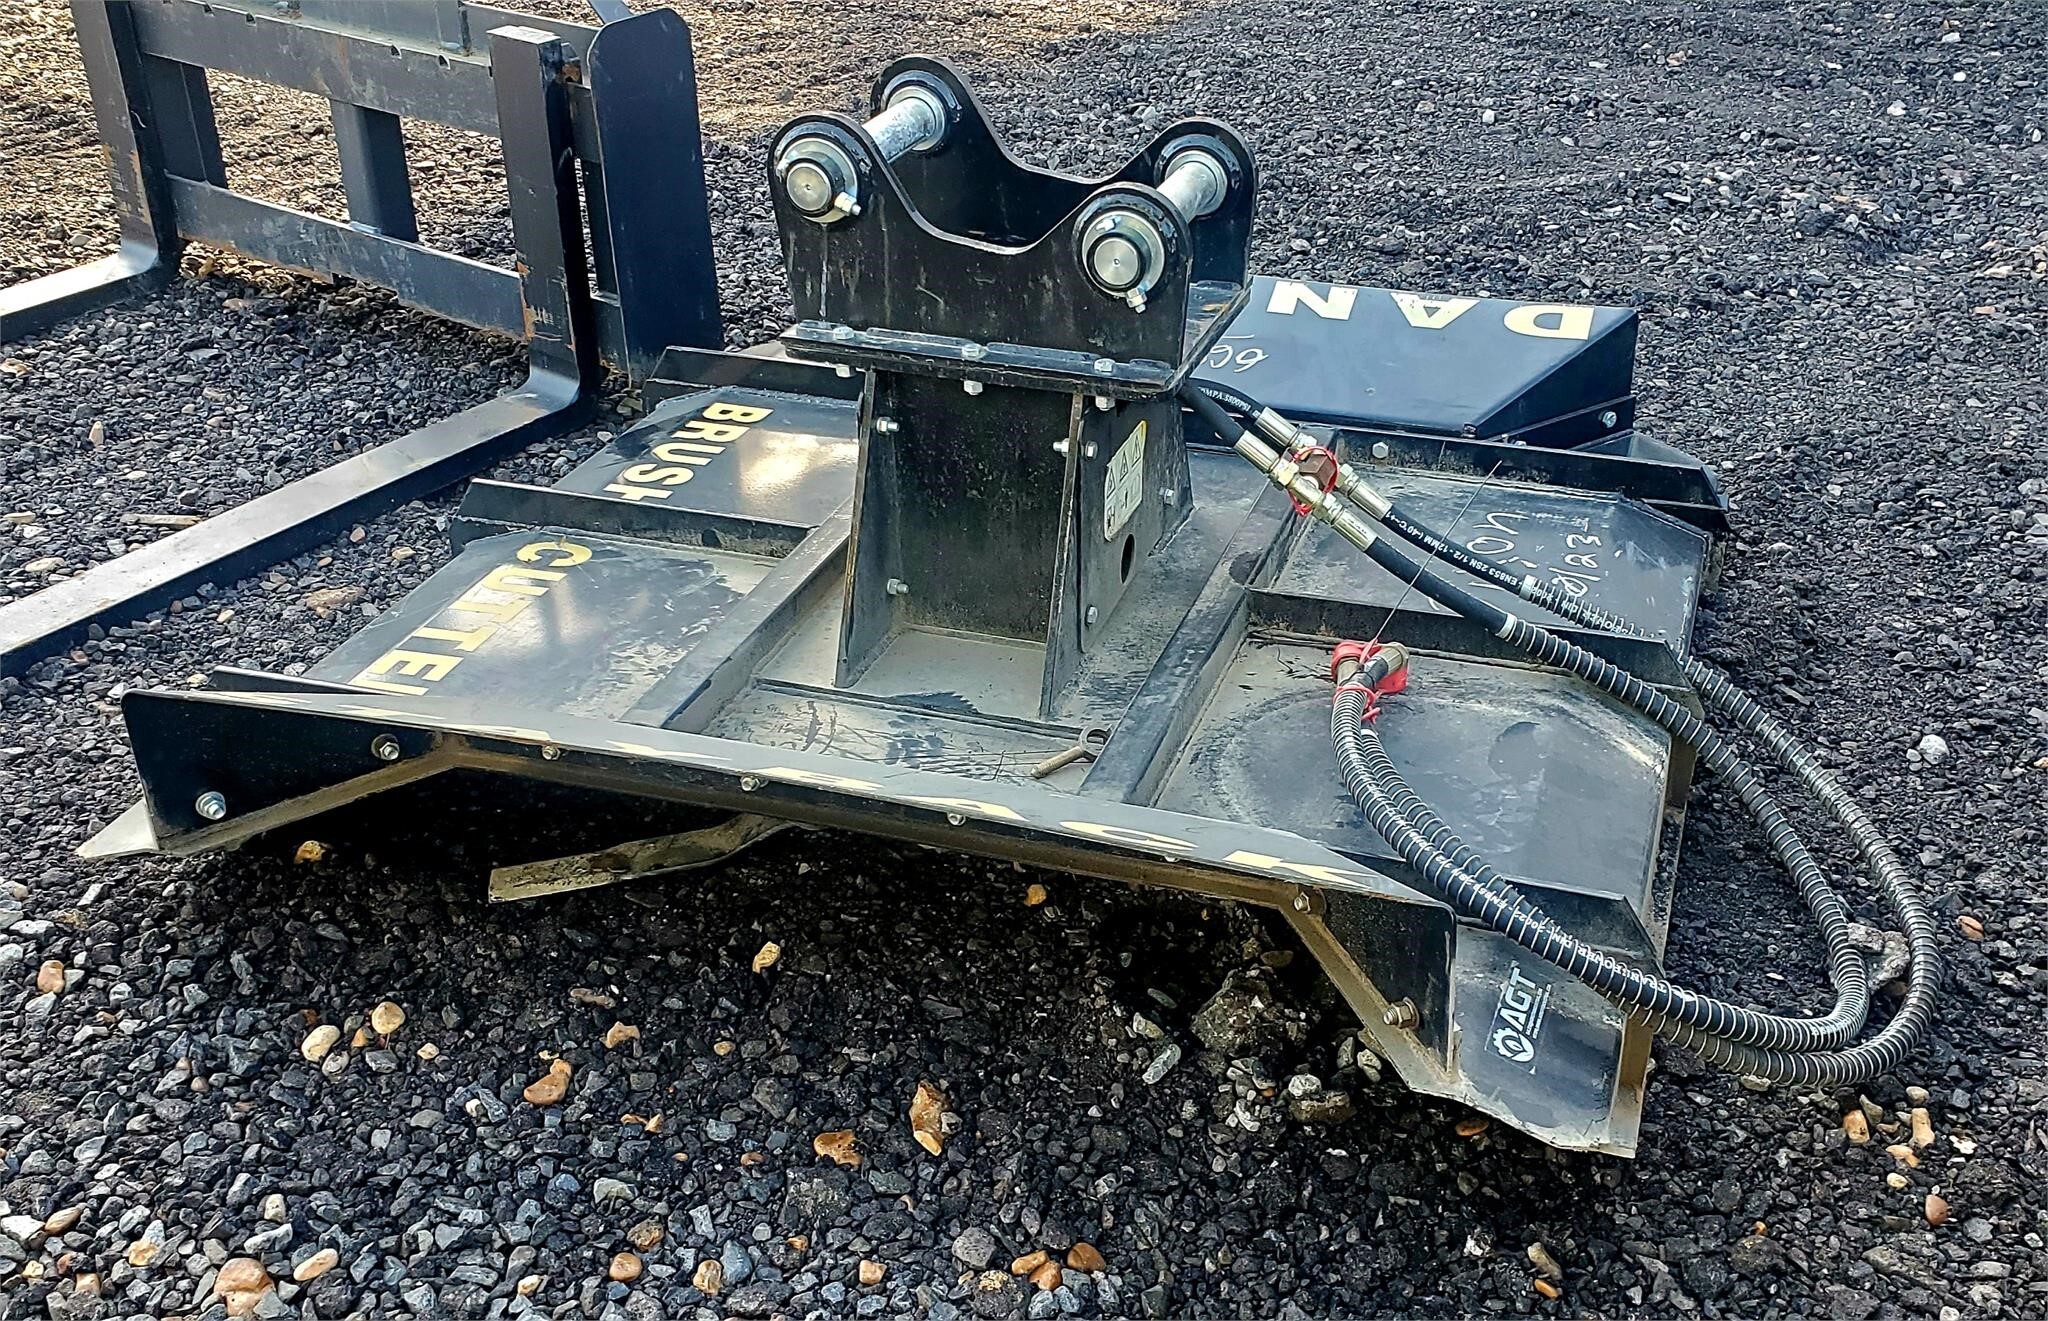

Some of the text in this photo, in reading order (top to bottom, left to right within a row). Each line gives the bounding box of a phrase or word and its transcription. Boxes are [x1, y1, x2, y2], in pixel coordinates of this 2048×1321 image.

[1265, 280, 1596, 341] DAN
[1487, 567, 1519, 586] EN853
[347, 540, 593, 696] CUTTE
[1499, 967, 1537, 1031] AGT
